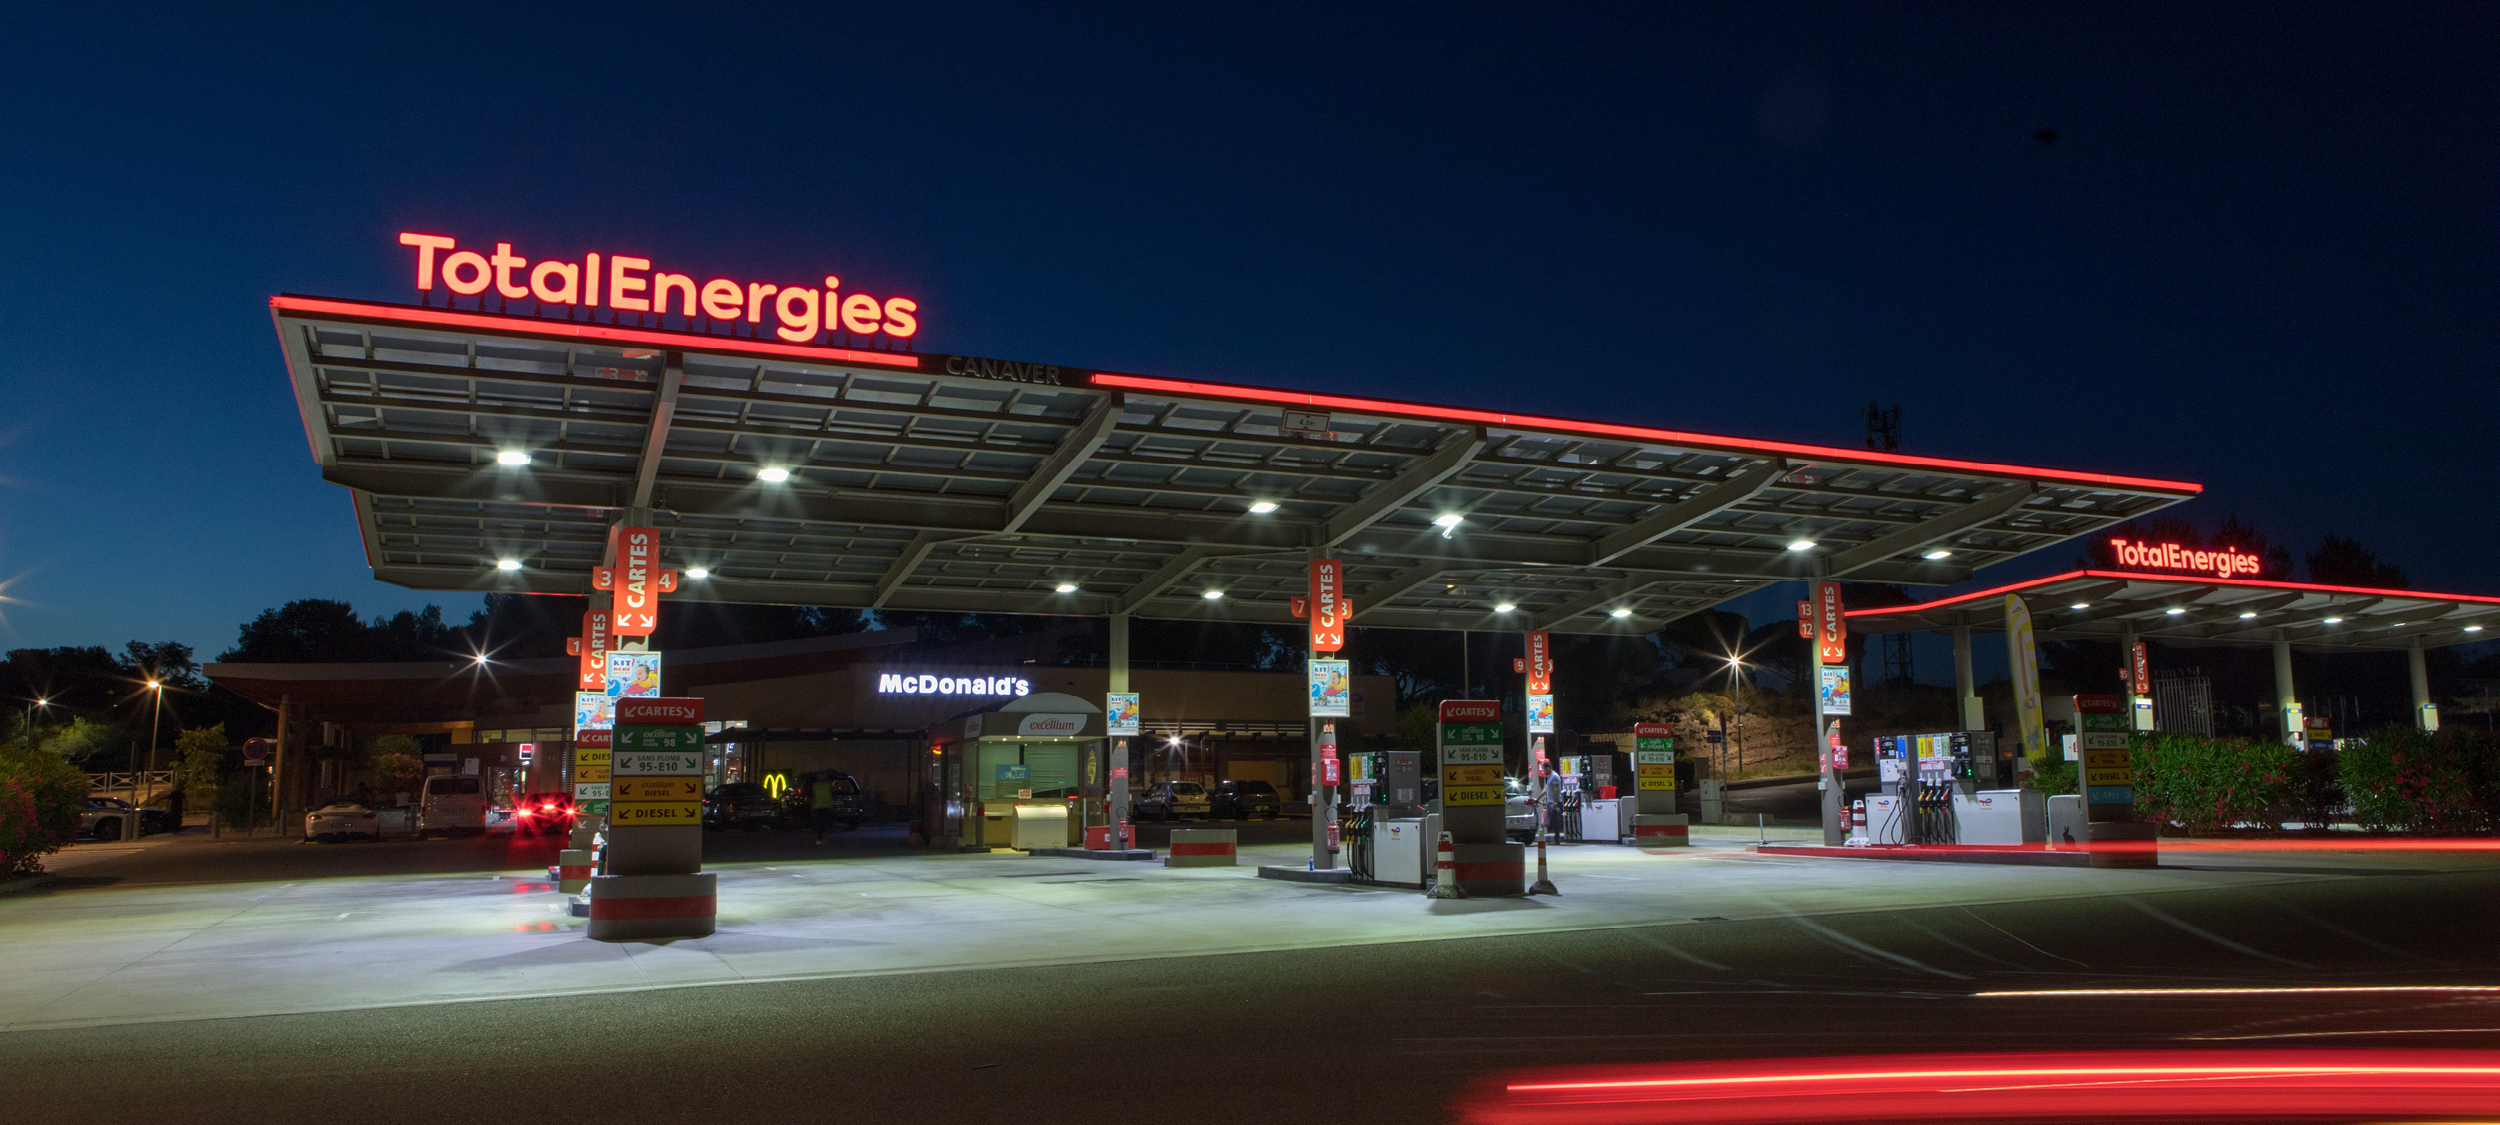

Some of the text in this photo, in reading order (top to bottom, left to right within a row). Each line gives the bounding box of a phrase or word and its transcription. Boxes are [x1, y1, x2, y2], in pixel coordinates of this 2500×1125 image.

[399, 232, 919, 342] TotalEnergies
[945, 355, 1062, 386] CANAVER
[2111, 539, 2260, 579] TotalEnergies
[627, 533, 648, 608] CARTES
[601, 571, 612, 587] 3
[659, 573, 671, 588] 4
[1320, 564, 1335, 628] CARTES
[1297, 600, 1305, 614] 7
[1800, 603, 1812, 616] 13
[1824, 586, 1838, 643] CARTES
[1801, 623, 1813, 636] 12
[573, 640, 580, 652] 1
[591, 613, 607, 669] CARTES
[1533, 634, 1544, 679] CARTES
[2135, 645, 2145, 681] CARTES
[1517, 660, 1524, 671] 9
[2119, 670, 2128, 678] 15
[879, 673, 1030, 697] McDonald's
[2087, 699, 2110, 707] CARTES
[637, 706, 683, 717] CARTES
[1455, 707, 1486, 716] CARTES
[1030, 718, 1075, 731] excellium
[643, 730, 677, 738] excellium
[664, 739, 676, 747] 98
[1461, 753, 1487, 761] 95-E10
[639, 763, 678, 772] 95-E10
[1461, 791, 1489, 800] DIESEL
[635, 809, 678, 818] DIESEL
